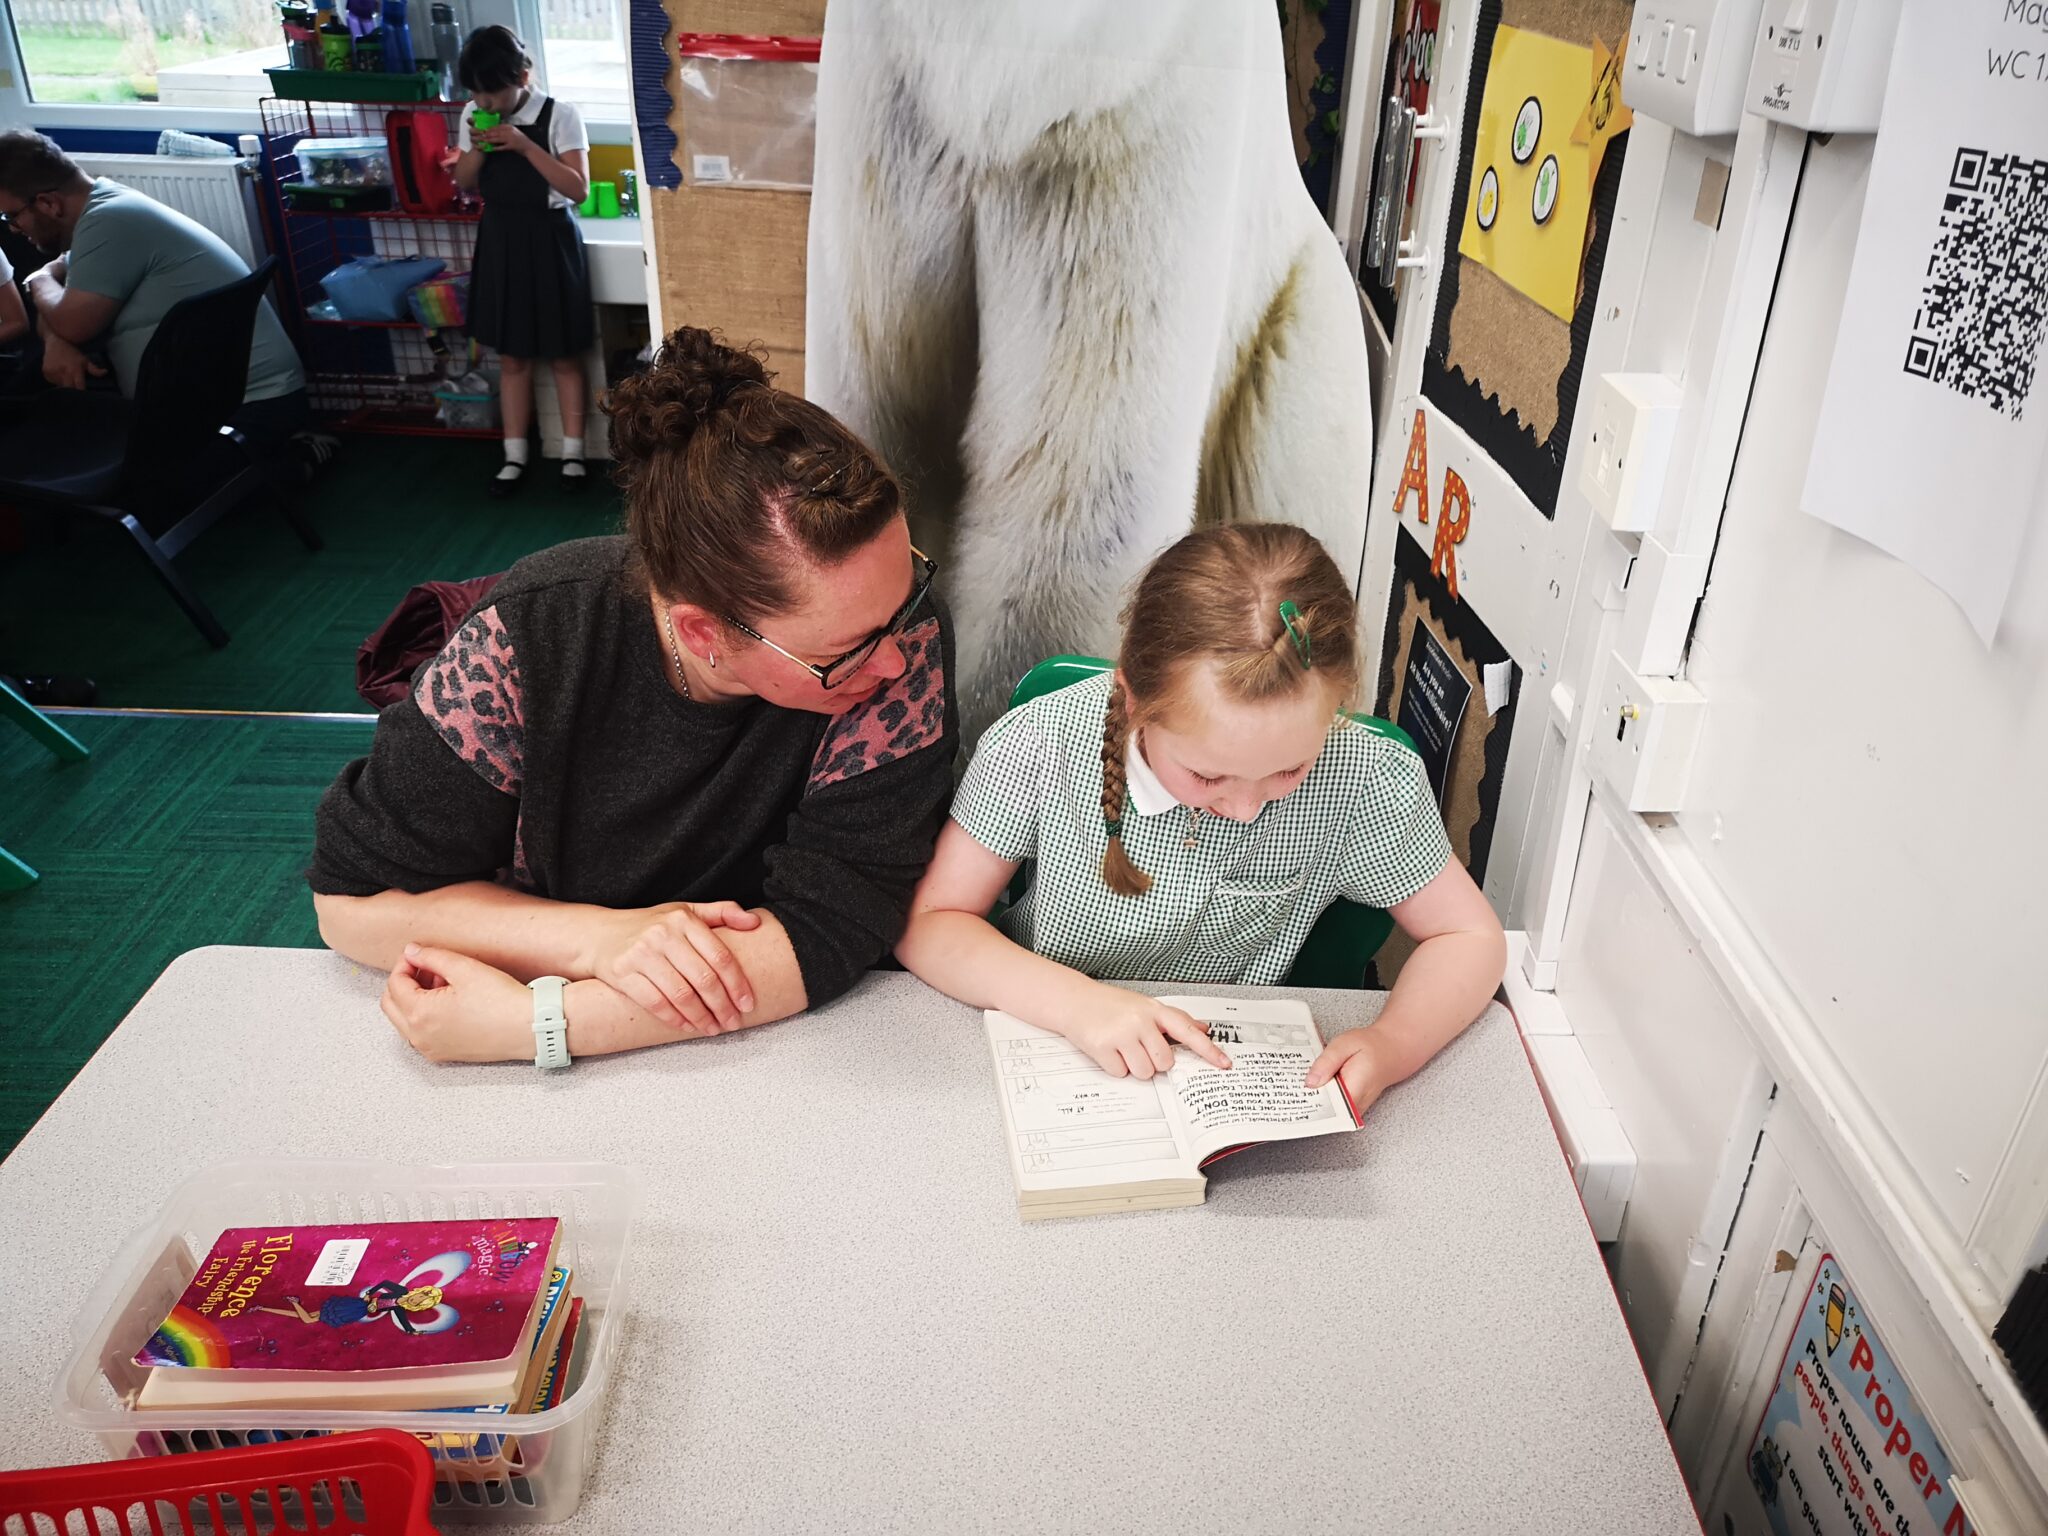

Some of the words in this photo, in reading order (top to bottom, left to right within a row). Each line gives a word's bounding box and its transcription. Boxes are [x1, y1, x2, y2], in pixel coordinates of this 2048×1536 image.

[1988, 48, 2030, 79] WC
[2037, 53, 2048, 81] 1
[1422, 661, 1431, 678] Are
[1429, 673, 1439, 690] you
[1437, 686, 1445, 700] an
[1425, 686, 1452, 732] Millionaire?
[1214, 1022, 1235, 1030] WHAT
[1183, 1085, 1236, 1104] EQUIPMENT!
[1187, 1074, 1223, 1085] UNIVERSE!
[1077, 1106, 1085, 1114] AT
[1189, 1097, 1205, 1107] ANY
[1196, 1099, 1229, 1115] DON'T
[240, 1239, 257, 1260] the
[473, 1237, 493, 1276] magic
[195, 1257, 230, 1288] Fairy
[197, 1256, 254, 1313] Friendship
[220, 1232, 293, 1319] Florence
[1794, 1360, 1829, 1434] people,
[1831, 1431, 1865, 1501] things
[1805, 1337, 1840, 1406] Proper
[1838, 1408, 1873, 1475] nouns
[1873, 1477, 1895, 1514] are
[1849, 1333, 1942, 1500] Proper
[1783, 1451, 1791, 1467] I
[1789, 1468, 1803, 1500] am
[1817, 1445, 1844, 1499] start
